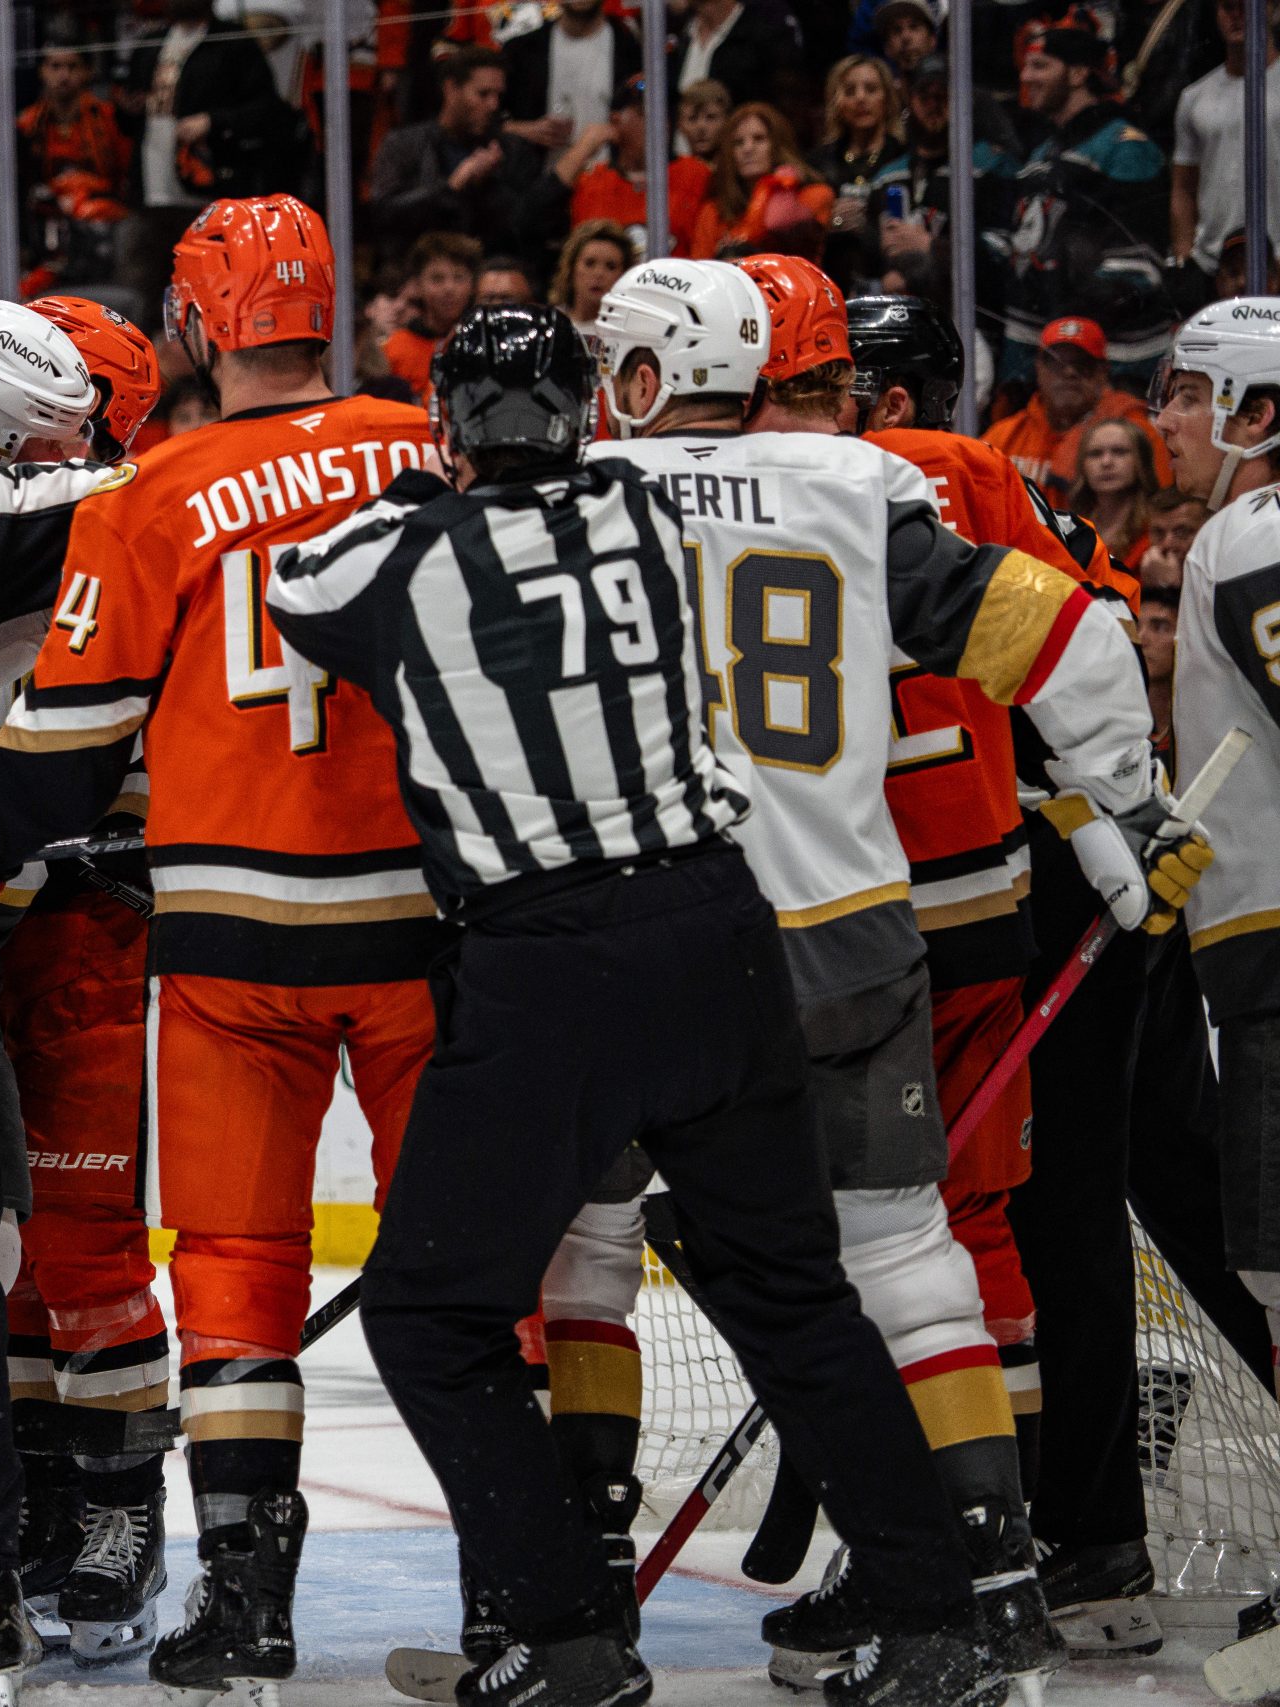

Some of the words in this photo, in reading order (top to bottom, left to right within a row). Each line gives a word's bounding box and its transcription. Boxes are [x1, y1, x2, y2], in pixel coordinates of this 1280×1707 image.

[276, 260, 305, 286] 44
[653, 271, 692, 294] NAQVI
[739, 318, 759, 345] 48
[8, 339, 50, 373] NAQVI
[186, 441, 436, 549] JOHNSTO
[55, 572, 100, 652] 4
[516, 559, 660, 678] 79
[26, 1151, 130, 1172] BAUER
